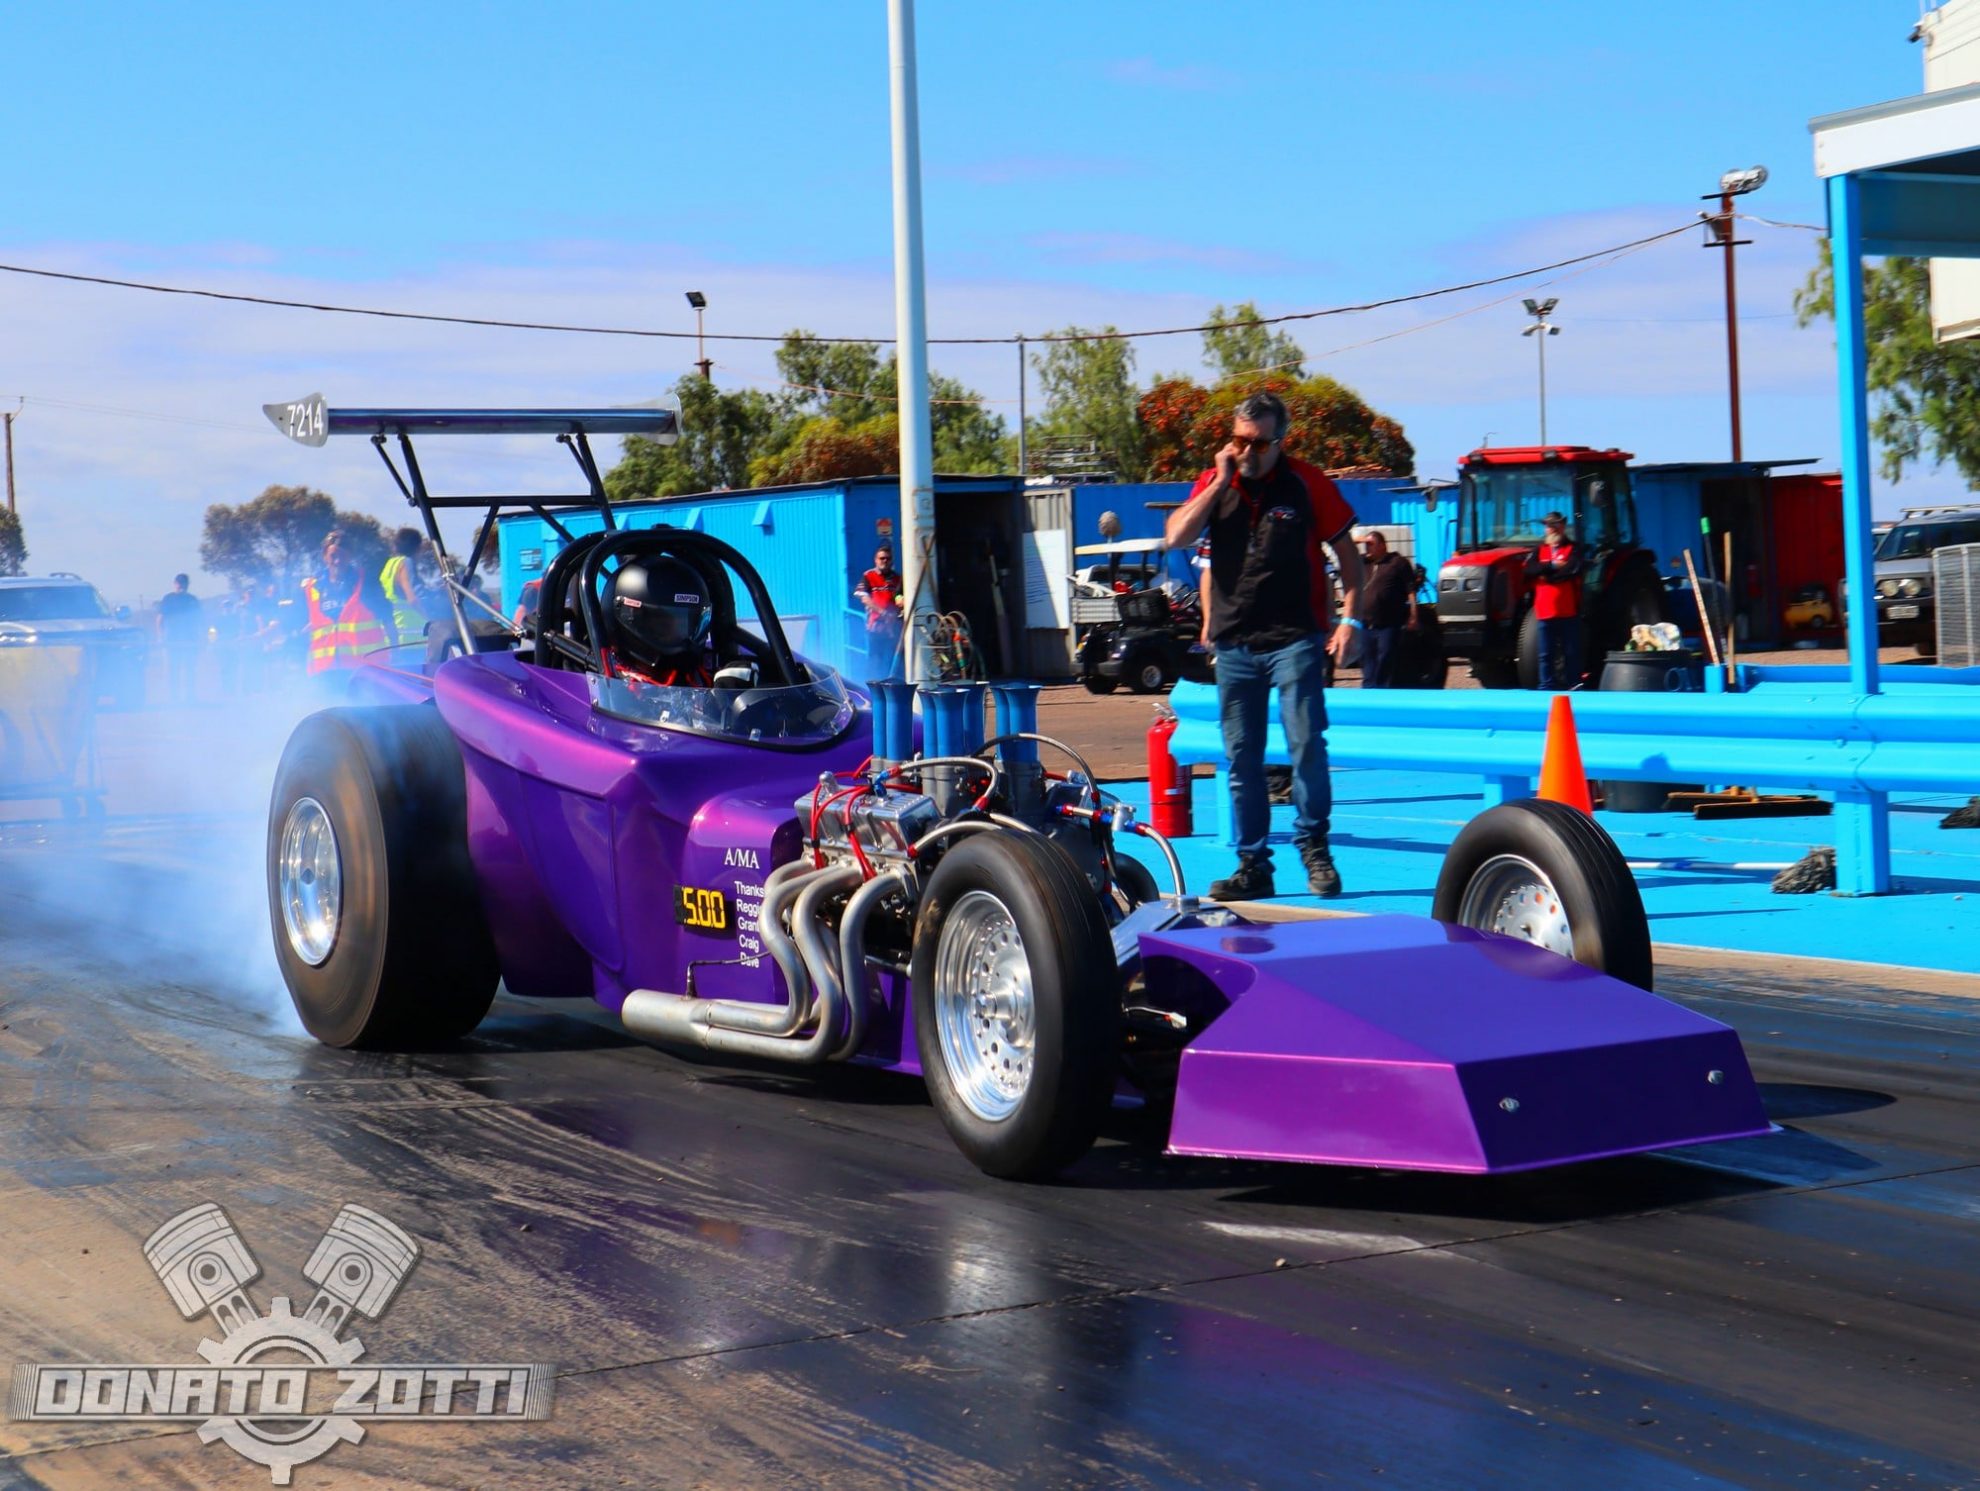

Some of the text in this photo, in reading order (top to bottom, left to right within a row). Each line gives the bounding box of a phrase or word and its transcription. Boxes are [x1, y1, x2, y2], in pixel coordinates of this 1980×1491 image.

[287, 402, 323, 437] 7214
[724, 848, 760, 869] A/MA
[734, 881, 765, 897] Thanks
[736, 899, 761, 917] Reggi
[739, 934, 759, 953] Craig
